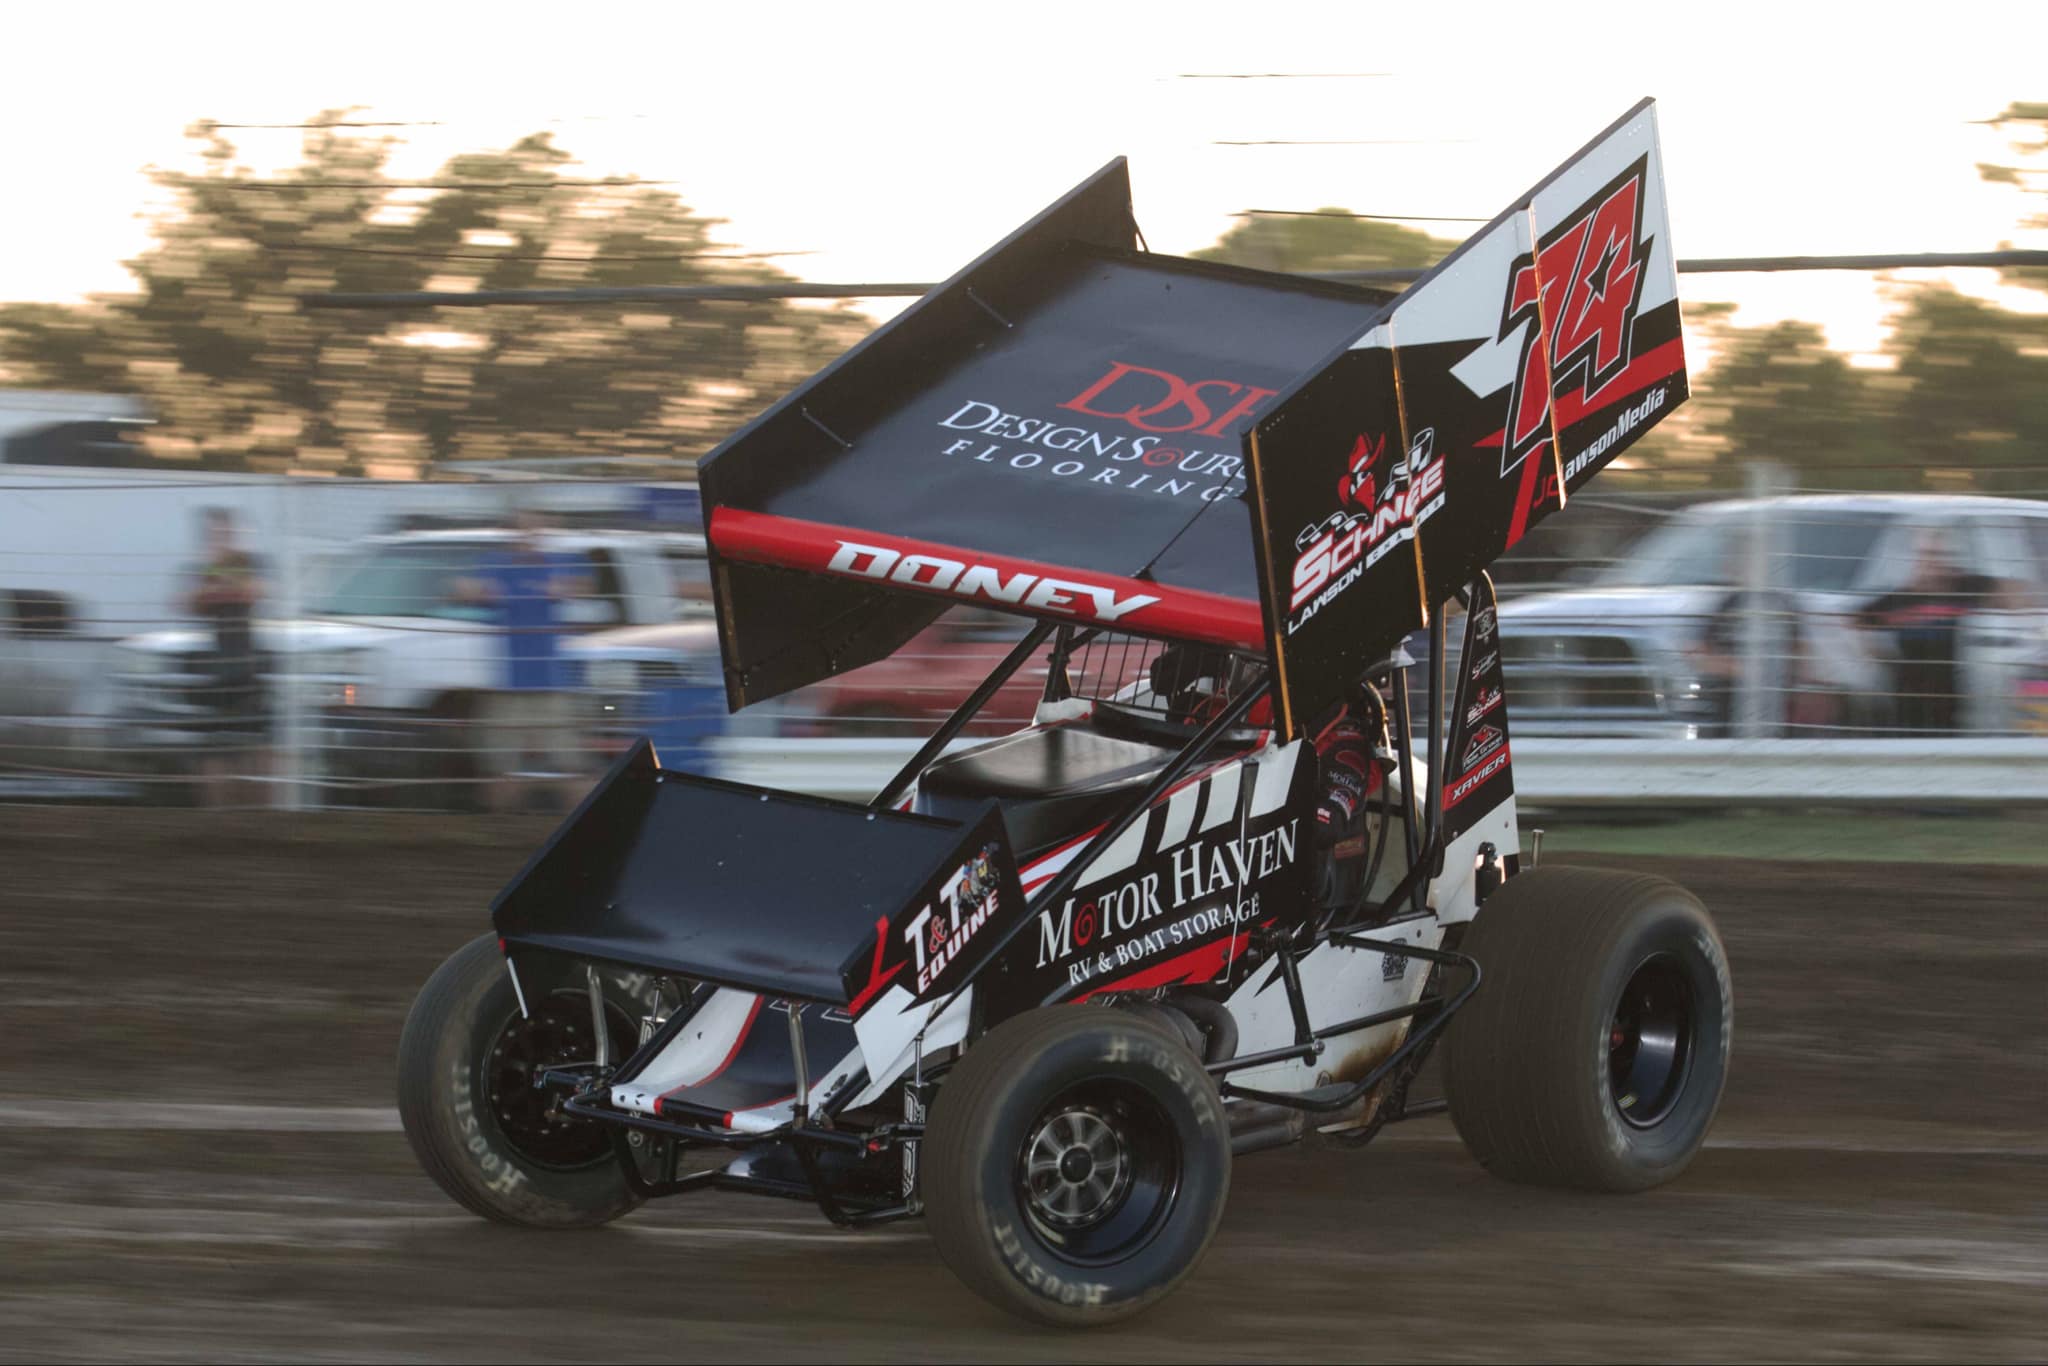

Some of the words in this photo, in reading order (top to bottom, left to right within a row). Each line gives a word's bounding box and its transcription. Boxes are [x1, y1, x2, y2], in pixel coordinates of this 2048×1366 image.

[1503, 163, 1644, 462] 74
[937, 400, 1246, 478] DESIGNSOUR
[942, 439, 1236, 501] FLOORING
[1291, 456, 1445, 609] SCHNEE
[826, 540, 1162, 622] DONEY
[1288, 562, 1363, 635] LAWSON
[1453, 753, 1506, 800] XAVIER
[1036, 872, 1162, 969] MOTOR
[1171, 819, 1298, 907] HAVEN
[917, 889, 999, 994] EQUINE
[1068, 958, 1092, 986] RV
[1098, 952, 1113, 973] &
[1115, 927, 1167, 965] BOAT
[1170, 897, 1260, 945] STORAGE
